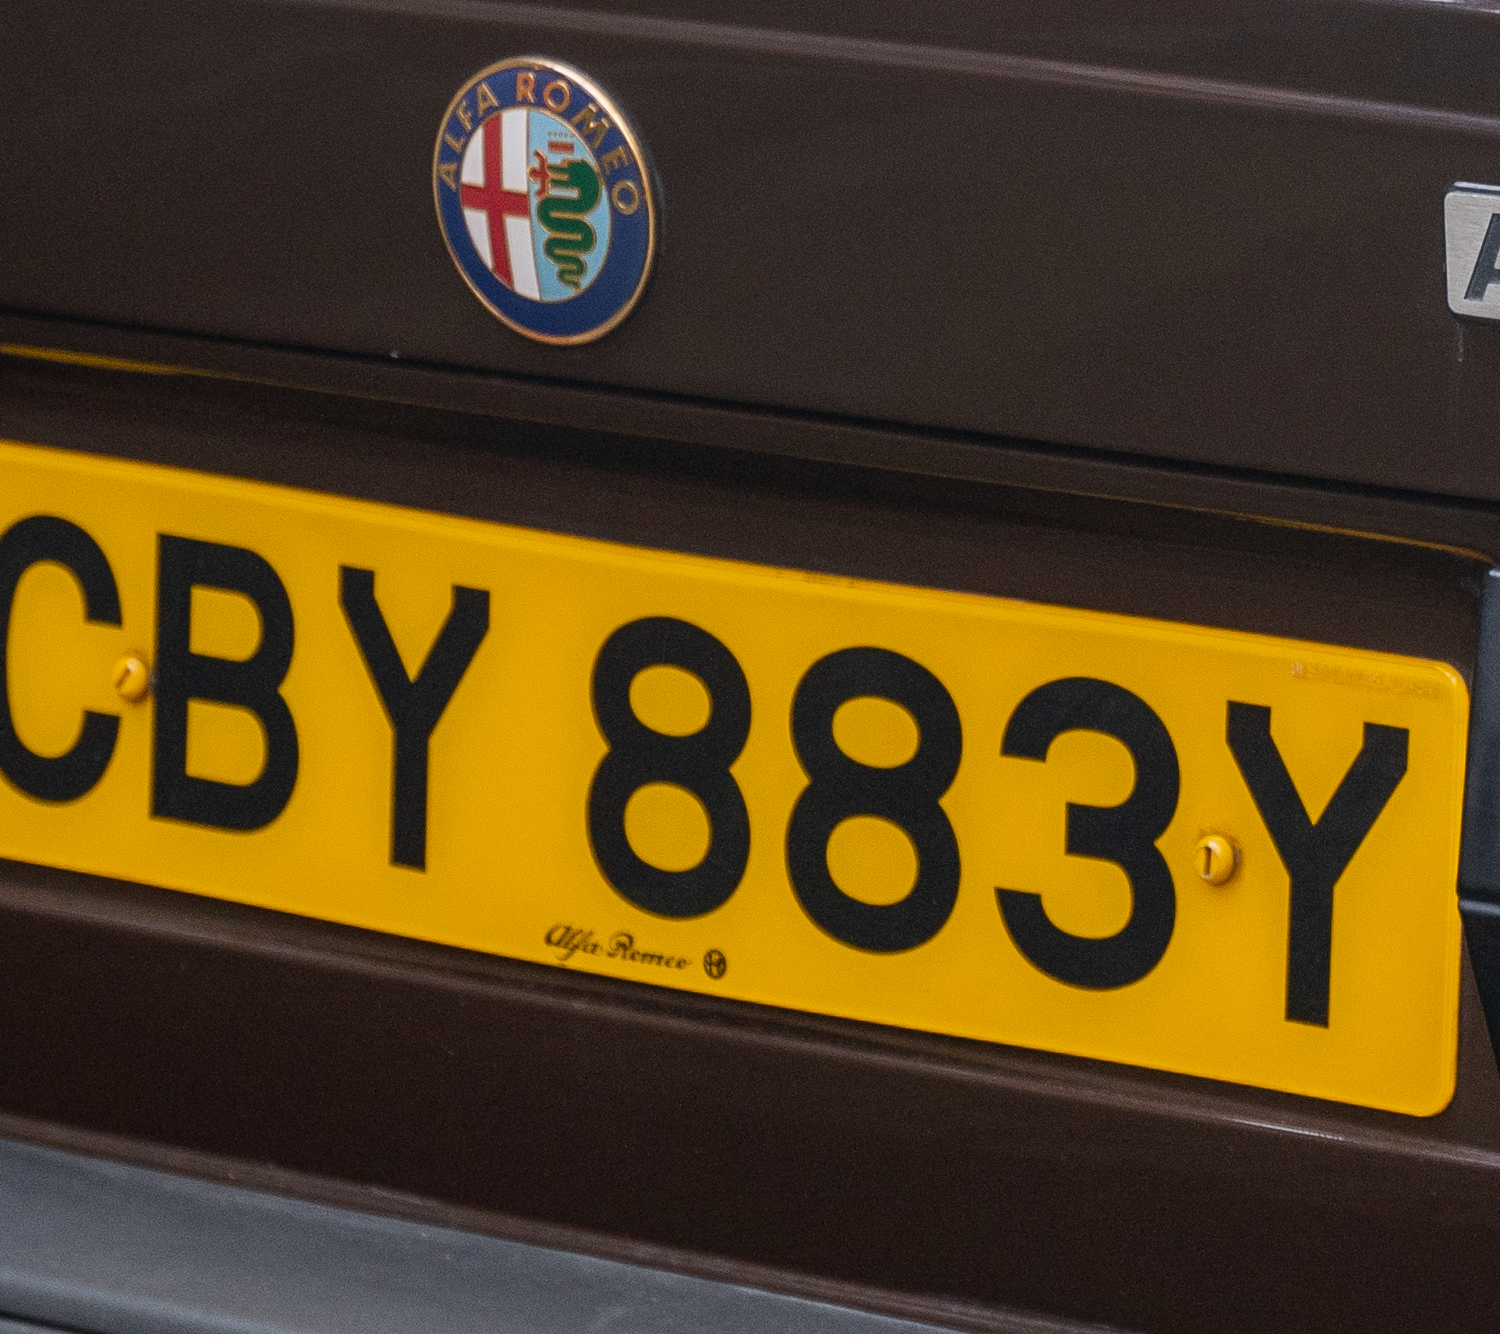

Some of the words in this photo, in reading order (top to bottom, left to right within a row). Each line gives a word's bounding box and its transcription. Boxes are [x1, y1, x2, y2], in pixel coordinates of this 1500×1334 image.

[437, 82, 499, 192] ALFA
[515, 71, 639, 216] ROMEO
[586, 616, 1411, 1029] 883Y
[543, 923, 603, 961] Alfa
[606, 929, 691, 971] Romeo
